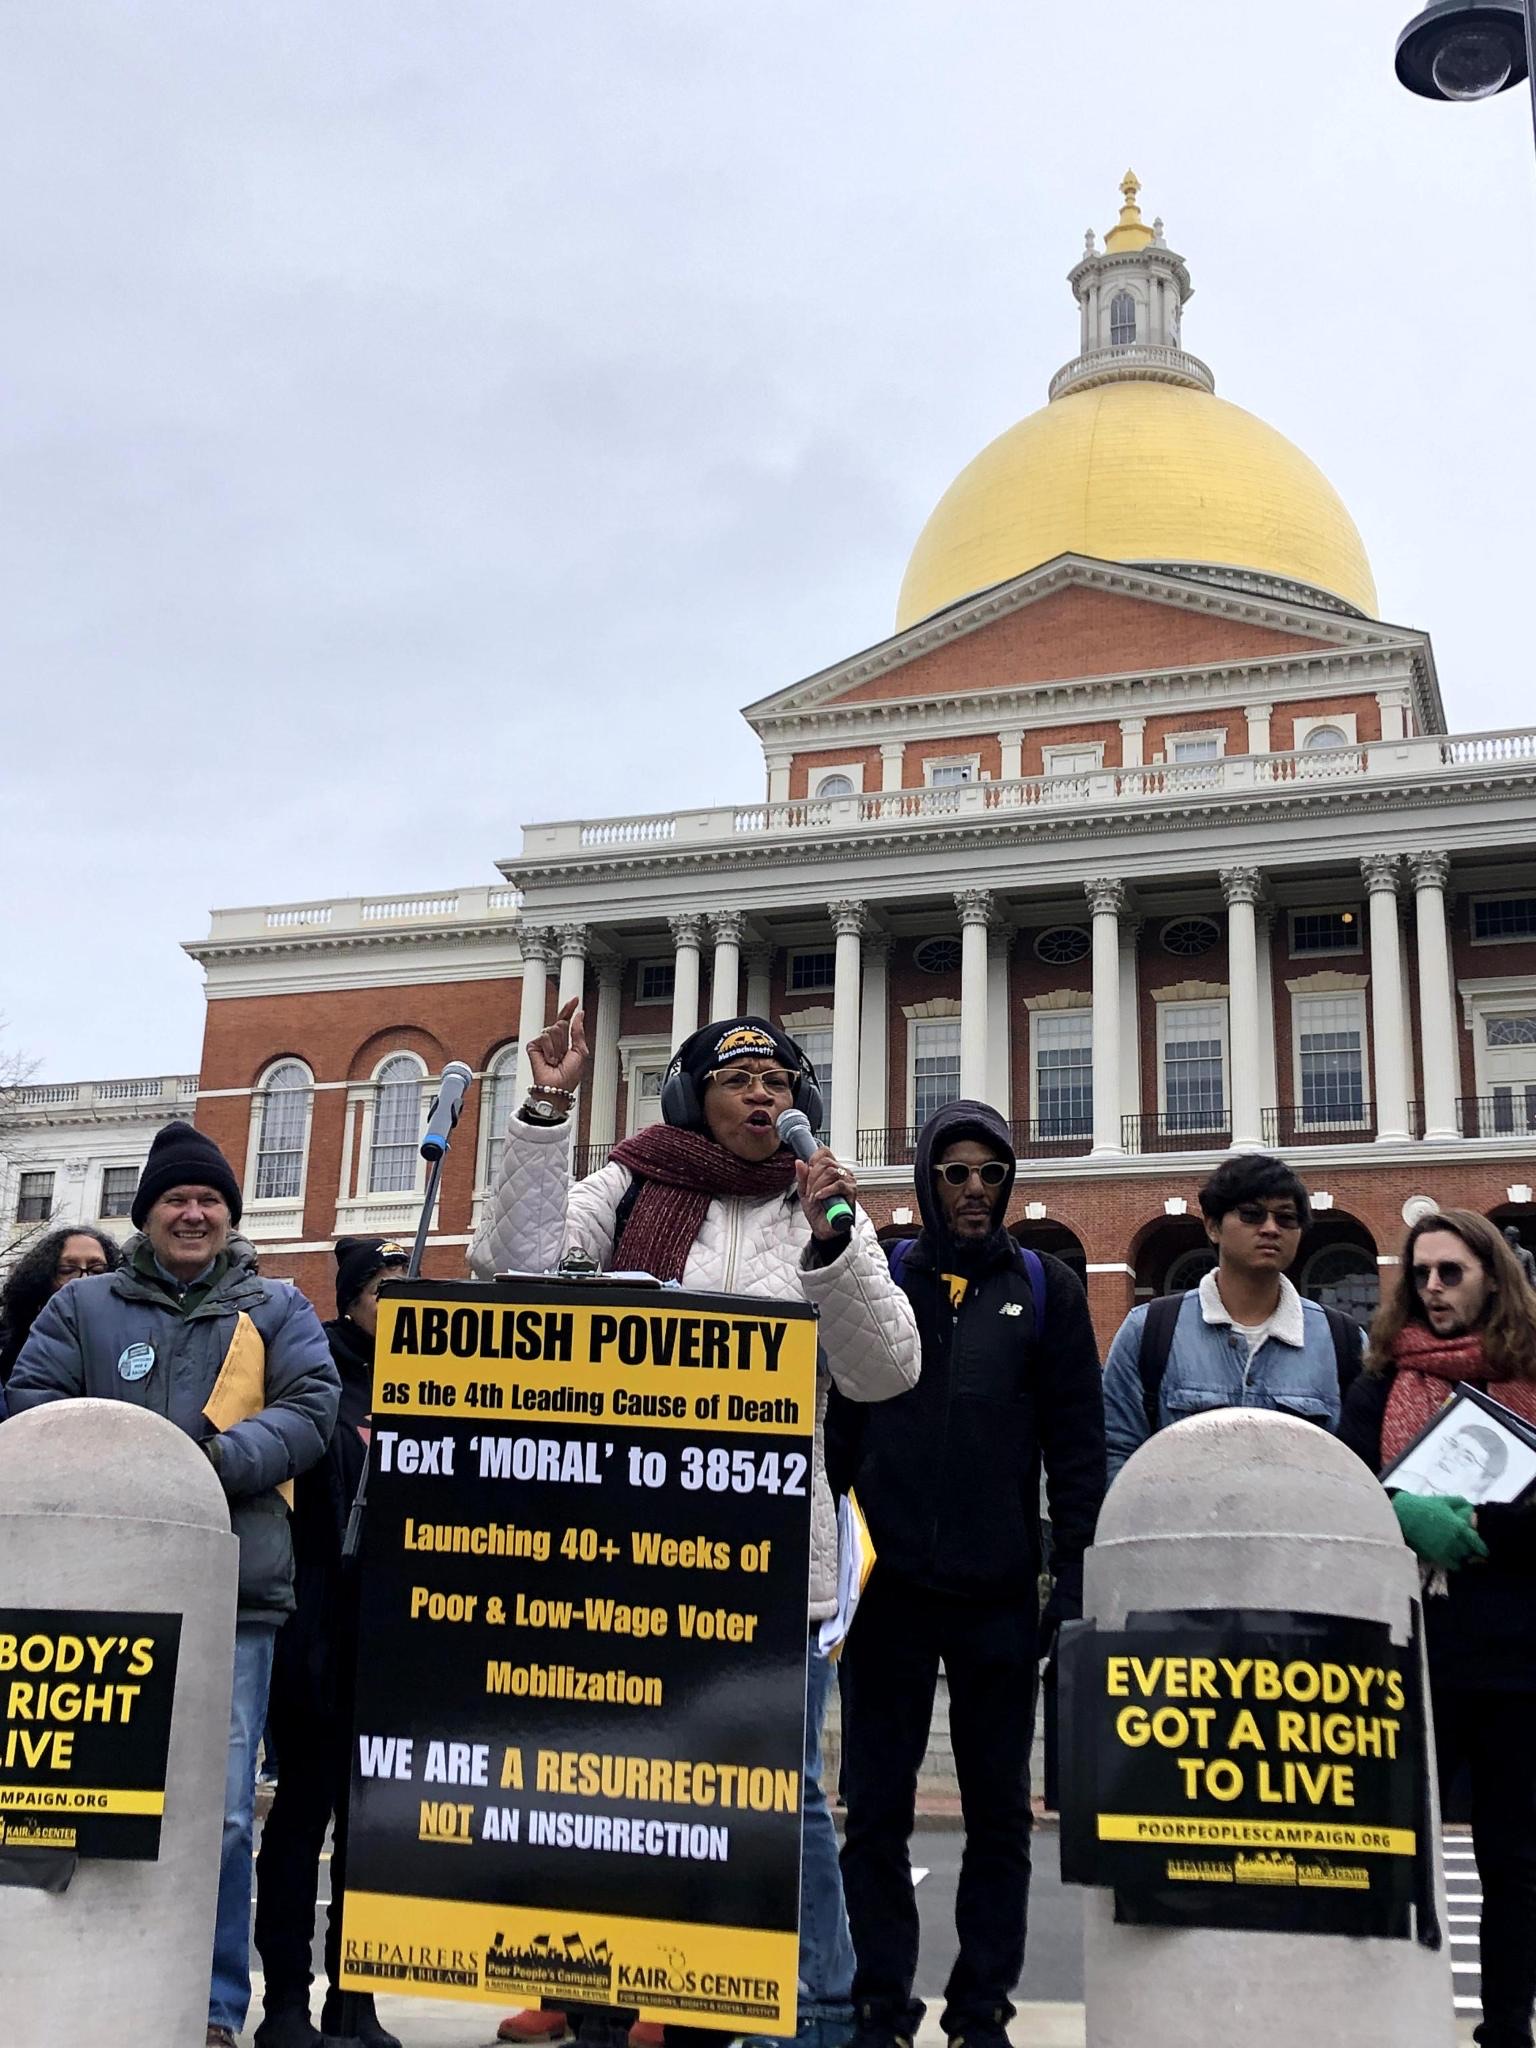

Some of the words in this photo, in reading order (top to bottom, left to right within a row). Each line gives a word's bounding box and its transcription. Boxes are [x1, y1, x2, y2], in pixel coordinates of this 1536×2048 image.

[718, 1045, 774, 1062] Massachusetts
[391, 1307, 574, 1361] ABOLISH
[590, 1315, 788, 1371] POVERTY
[382, 1382, 410, 1404] as
[418, 1380, 456, 1406] the
[464, 1382, 503, 1408] 4th
[511, 1384, 604, 1416] Leading
[613, 1388, 686, 1418] Cause
[695, 1394, 720, 1419] of
[728, 1395, 799, 1424] Death
[376, 1431, 455, 1476] Text
[469, 1436, 614, 1484] 'MORAL'
[627, 1446, 667, 1488] to
[680, 1447, 807, 1496] 38542
[404, 1519, 550, 1561] Launching
[560, 1527, 621, 1563] 40+
[632, 1531, 730, 1570] Weeks
[740, 1541, 771, 1573] of
[410, 1587, 478, 1623] Poor
[486, 1596, 506, 1625] &
[515, 1593, 668, 1638] Low-Wage
[678, 1605, 758, 1643] Voter
[0, 1634, 155, 1676] BODY'S
[7, 1682, 141, 1723] RIGHT
[486, 1660, 663, 1706] Mobilization
[1107, 1656, 1405, 1711] EVERYBODY'S
[0, 1729, 75, 1769] IVE
[1116, 1705, 1216, 1749] GOT
[1228, 1709, 1266, 1751] A
[1278, 1711, 1400, 1760] RIGHT
[359, 1735, 414, 1781] WE
[423, 1741, 490, 1787] ARE
[500, 1747, 523, 1790] A
[536, 1749, 798, 1814] RESURRECTION
[1178, 1758, 1244, 1802] TO
[1258, 1760, 1355, 1806] LIVE
[42, 1827, 76, 1840] CENTER
[419, 1801, 475, 1838] NOT
[482, 1806, 519, 1843] AN
[528, 1810, 729, 1862] INSURRECTION
[1137, 1822, 1392, 1848] POORPEOPLESCAMPAIGN.ORG
[345, 1939, 479, 1971] REPAIRERS
[346, 1961, 363, 1976] OF
[372, 1963, 399, 1979] THE
[418, 1967, 476, 1986] BREACH
[488, 1964, 511, 1976] Poor
[513, 1965, 555, 1982] People's
[557, 1968, 609, 1987] Campaign
[700, 1973, 780, 2001] CENTER
